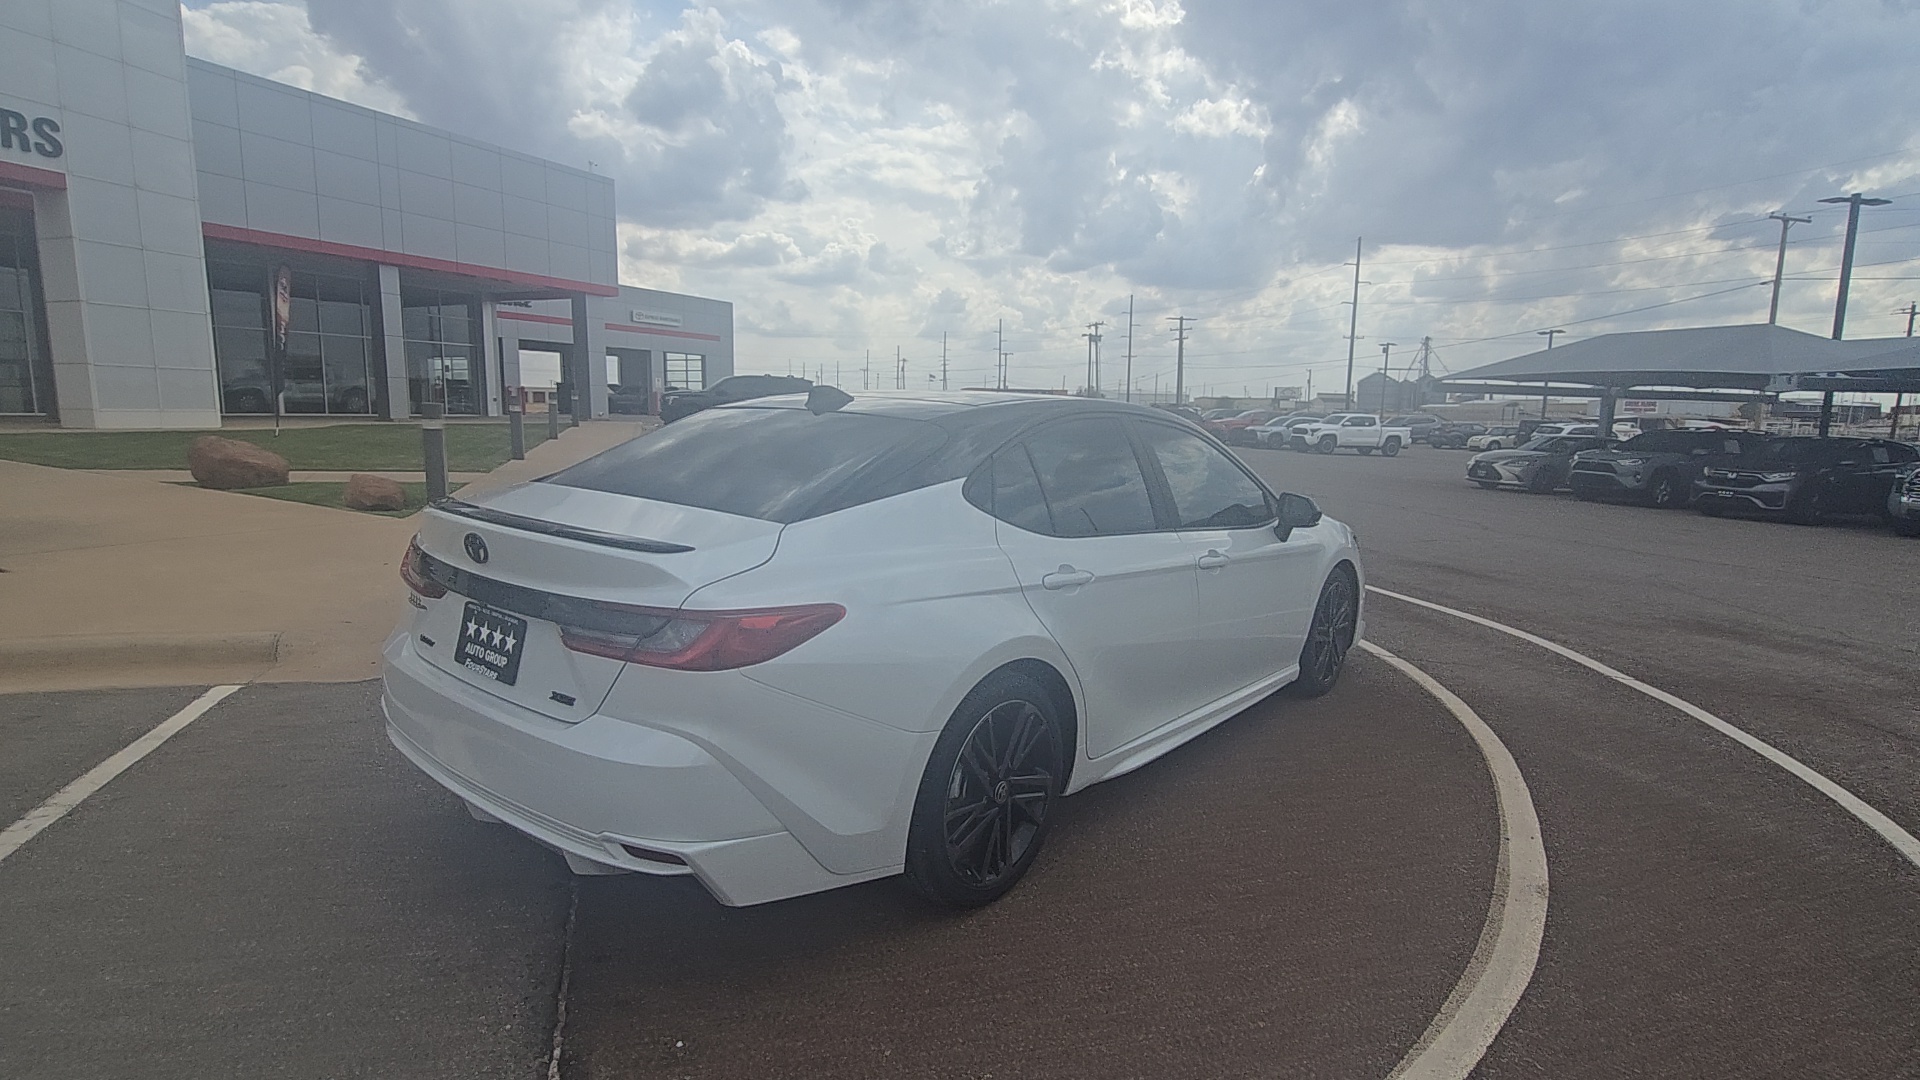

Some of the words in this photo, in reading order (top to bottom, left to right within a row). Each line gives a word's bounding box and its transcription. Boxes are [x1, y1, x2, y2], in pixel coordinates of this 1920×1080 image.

[0, 108, 63, 157] RS
[465, 642, 484, 658] AUTO
[485, 650, 508, 668] GROUP
